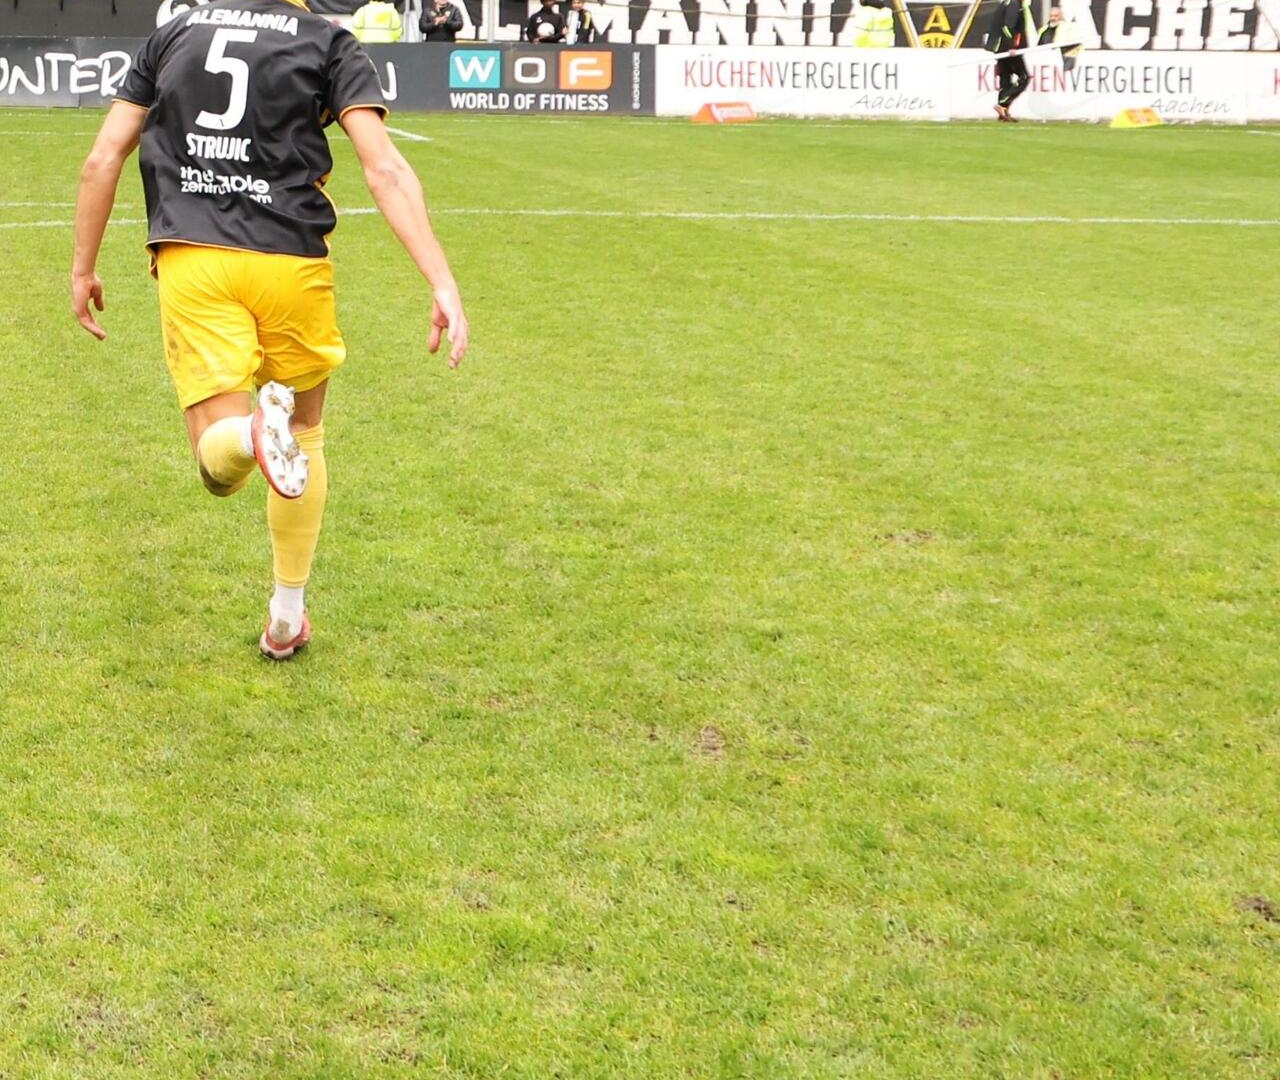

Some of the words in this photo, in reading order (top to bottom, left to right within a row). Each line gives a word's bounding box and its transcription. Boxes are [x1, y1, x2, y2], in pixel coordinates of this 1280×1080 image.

[186, 10, 299, 36] ALEMANNIA
[194, 28, 258, 131] 5
[683, 53, 899, 91] KÜCHENVERGLEICH
[450, 92, 510, 110] WORLD
[514, 93, 536, 110] OF
[540, 93, 609, 111] FITNESS
[850, 93, 937, 111] Aachen
[1149, 96, 1233, 113] Aachen
